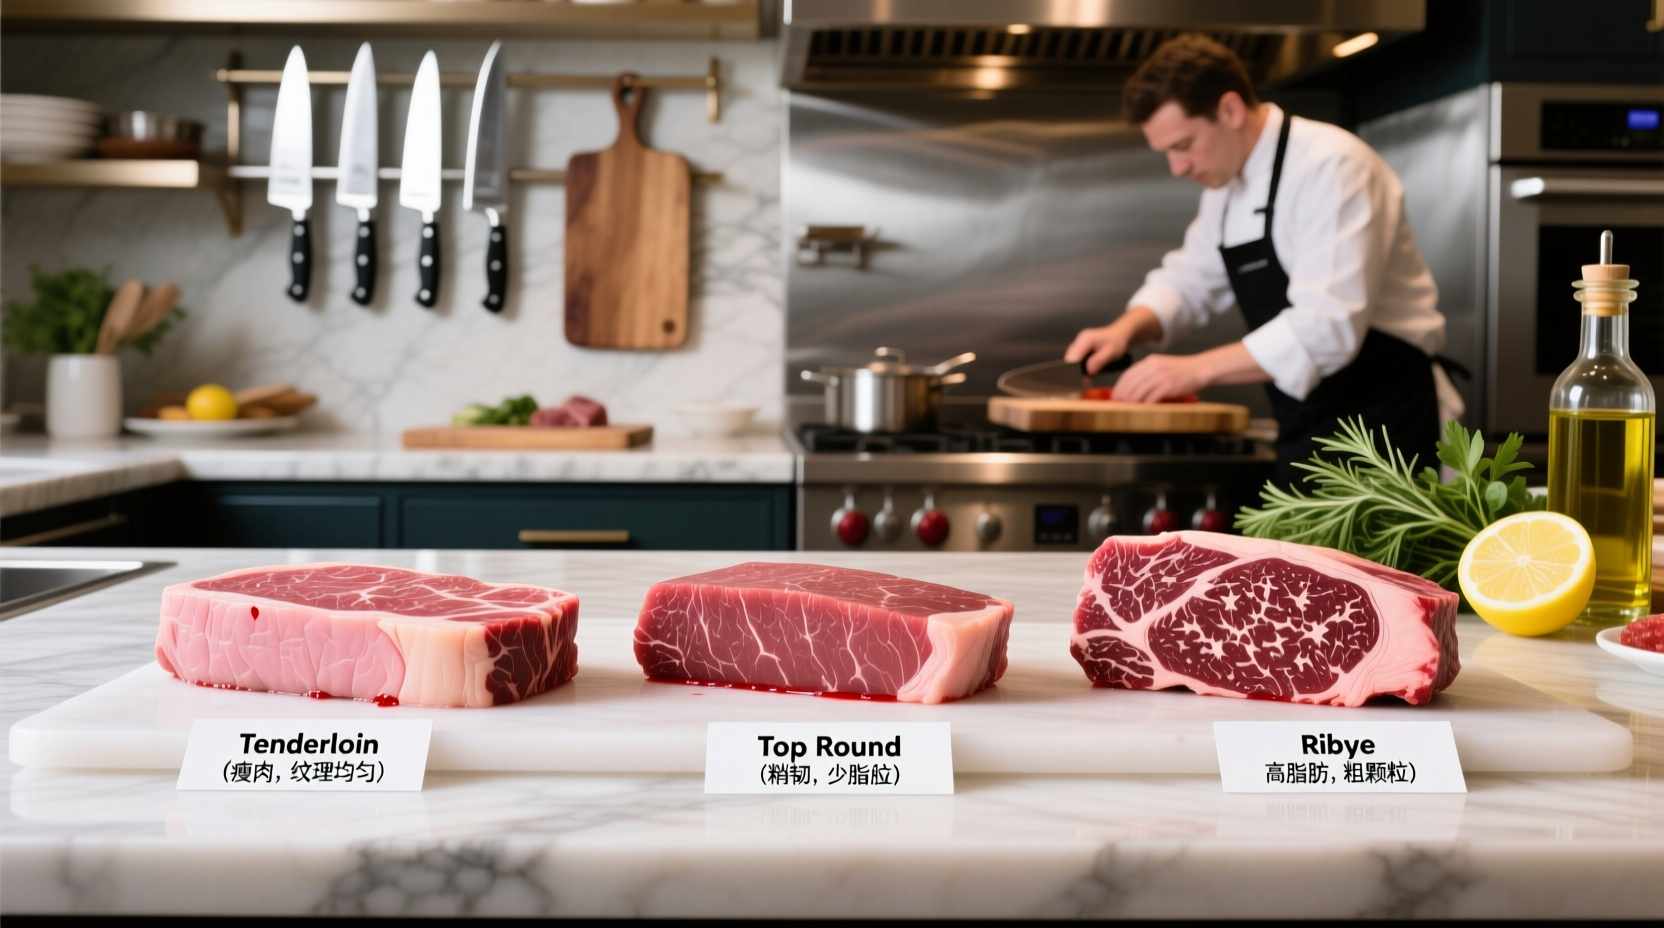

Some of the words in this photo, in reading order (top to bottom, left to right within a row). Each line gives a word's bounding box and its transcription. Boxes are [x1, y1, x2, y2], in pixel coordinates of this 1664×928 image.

[240, 732, 379, 755] Tenderloin
[757, 735, 808, 764] Top
[816, 735, 901, 757] Round
[1301, 733, 1376, 760] Ribye
